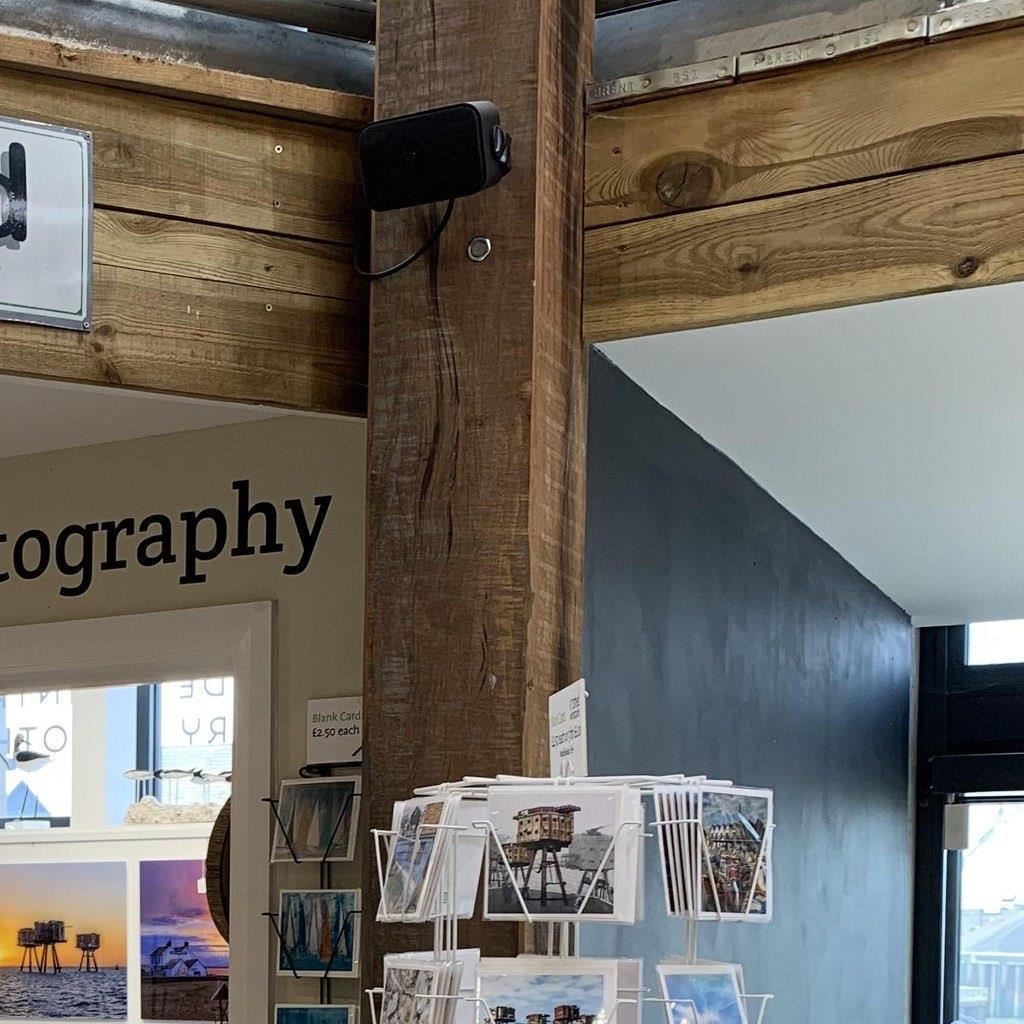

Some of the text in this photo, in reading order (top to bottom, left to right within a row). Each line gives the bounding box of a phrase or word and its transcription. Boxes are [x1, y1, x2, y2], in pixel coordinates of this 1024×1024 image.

[312, 711, 338, 723] Blank
[312, 724, 360, 738] £2.50 each
